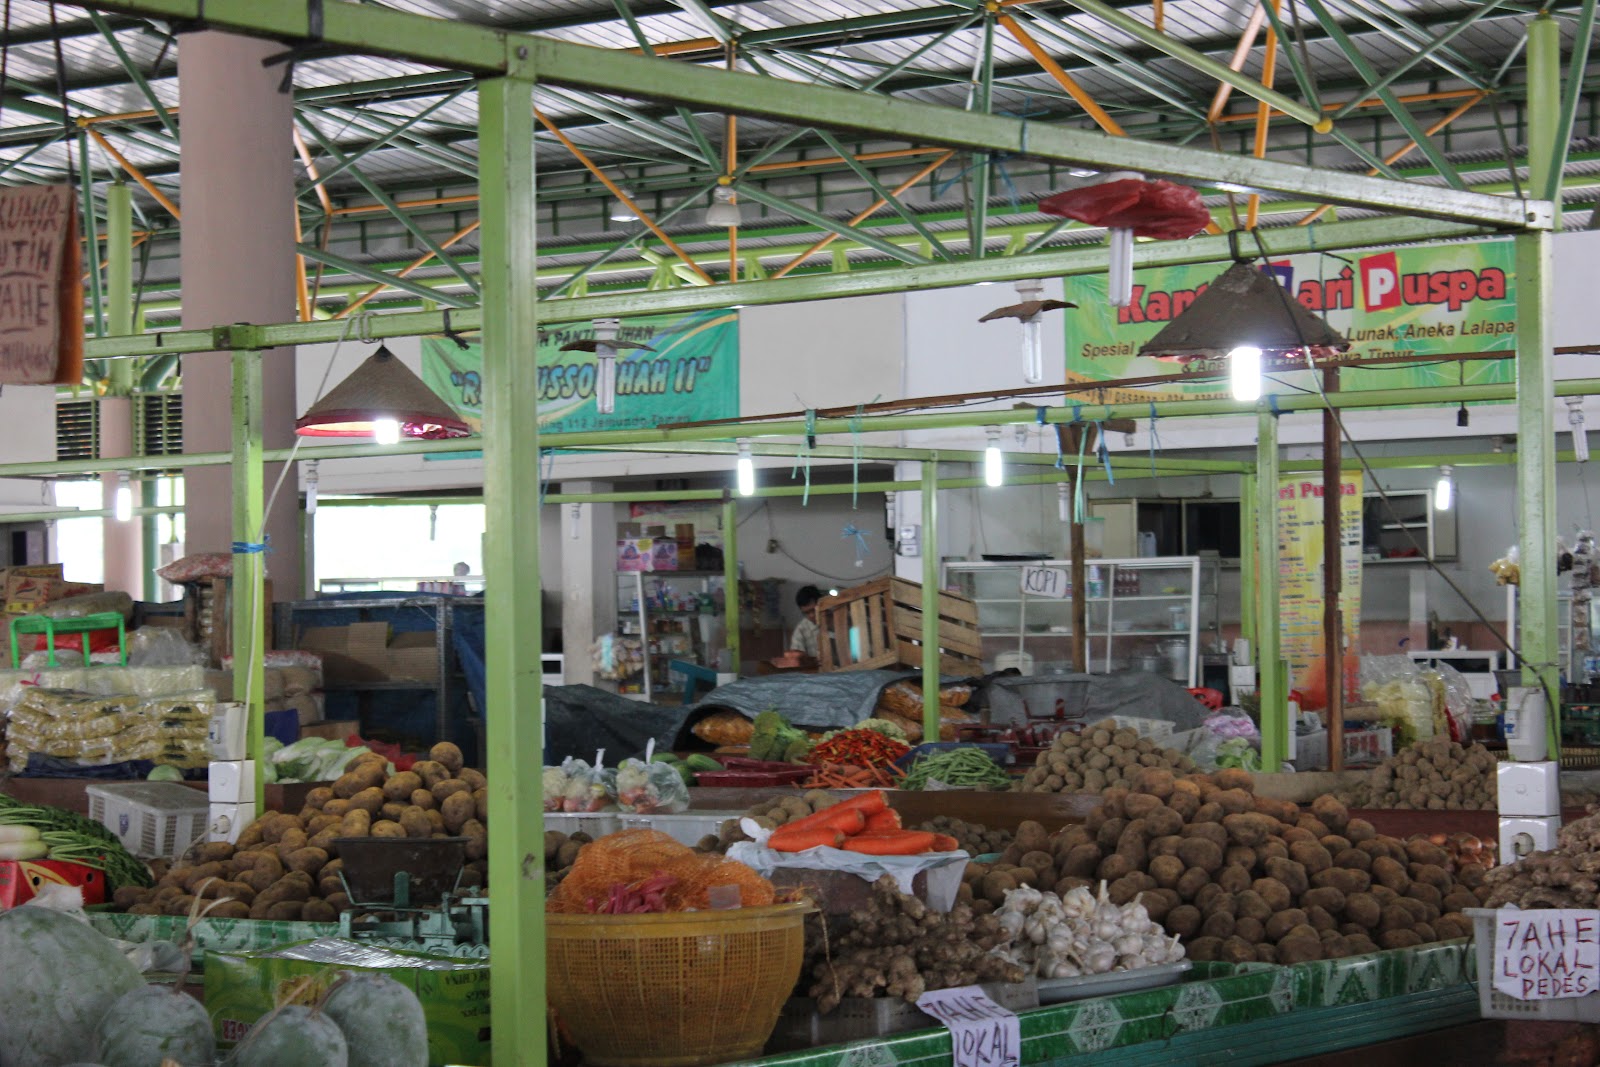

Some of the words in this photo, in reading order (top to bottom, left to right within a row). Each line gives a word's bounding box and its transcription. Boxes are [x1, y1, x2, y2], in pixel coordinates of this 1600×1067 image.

[0, 232, 52, 272] UTIH
[1367, 260, 1507, 312] Puspa
[0, 283, 49, 326] AHE
[616, 326, 656, 341] UHAN
[1402, 322, 1456, 338] Aneka
[1460, 319, 1517, 336] Lalapa
[1081, 341, 1135, 359] Spesial
[1300, 481, 1356, 498] Pua
[1024, 569, 1058, 593] KOPI
[1503, 948, 1594, 979] LOKAL
